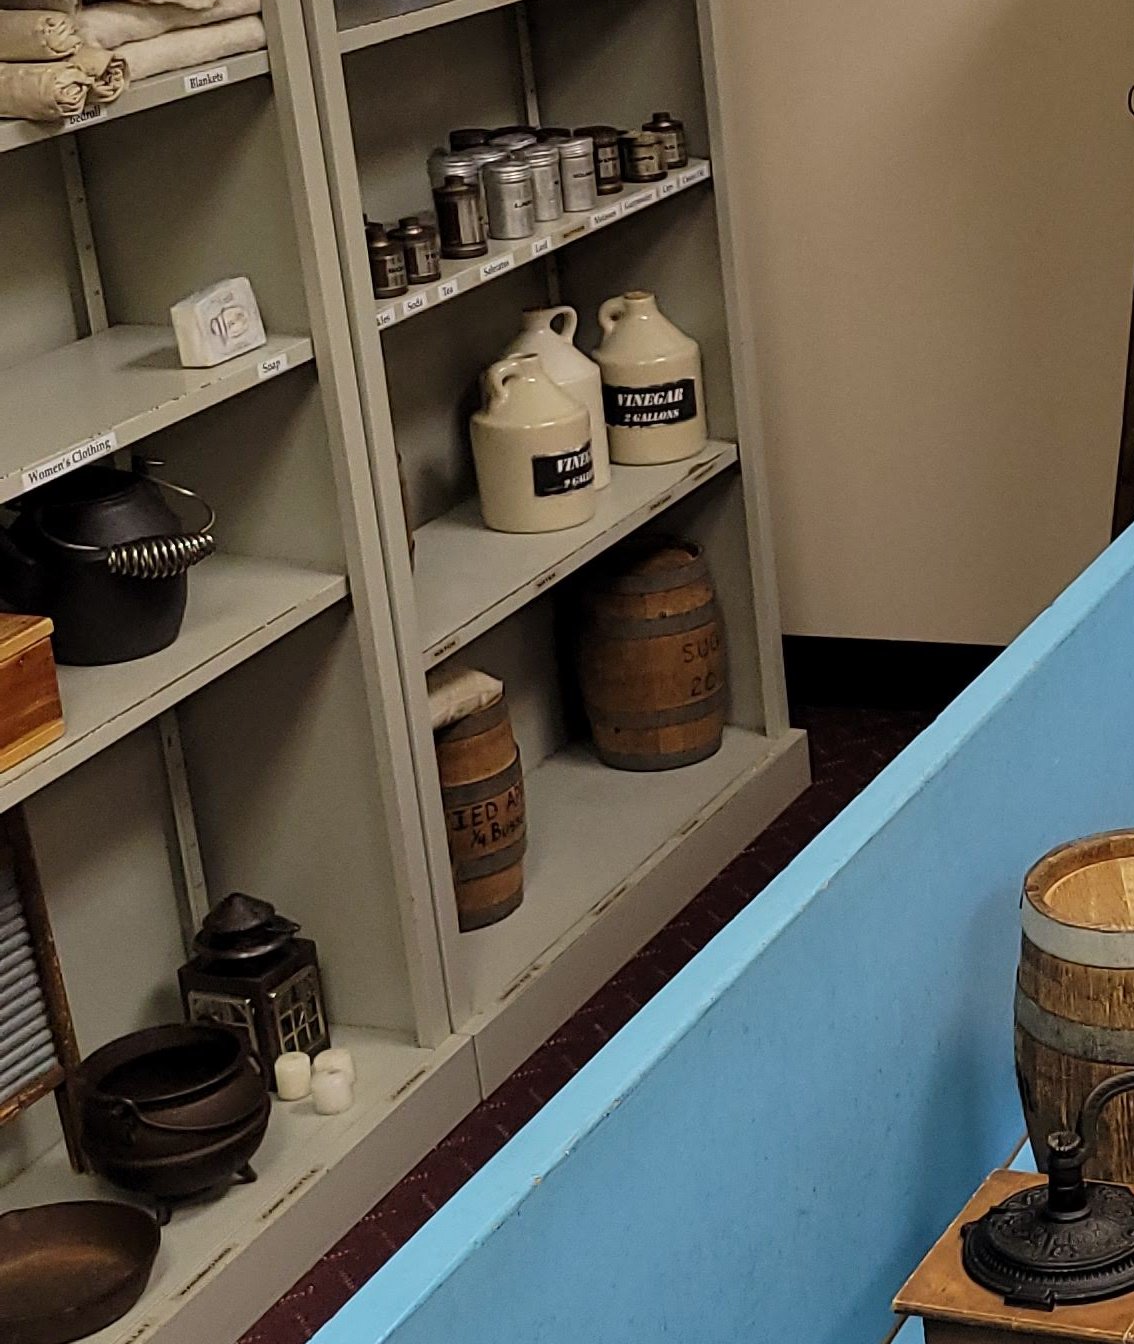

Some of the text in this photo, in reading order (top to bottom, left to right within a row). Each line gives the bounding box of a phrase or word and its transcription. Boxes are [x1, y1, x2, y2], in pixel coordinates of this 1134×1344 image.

[189, 72, 225, 89] Blankets
[442, 286, 454, 297] Tea
[407, 297, 424, 311] Soda
[262, 359, 281, 374] Soap
[617, 388, 684, 407] VINEGAR
[623, 408, 680, 423] 2 GALLONS
[27, 438, 111, 484] Women's Clothing
[450, 801, 499, 831] IED
